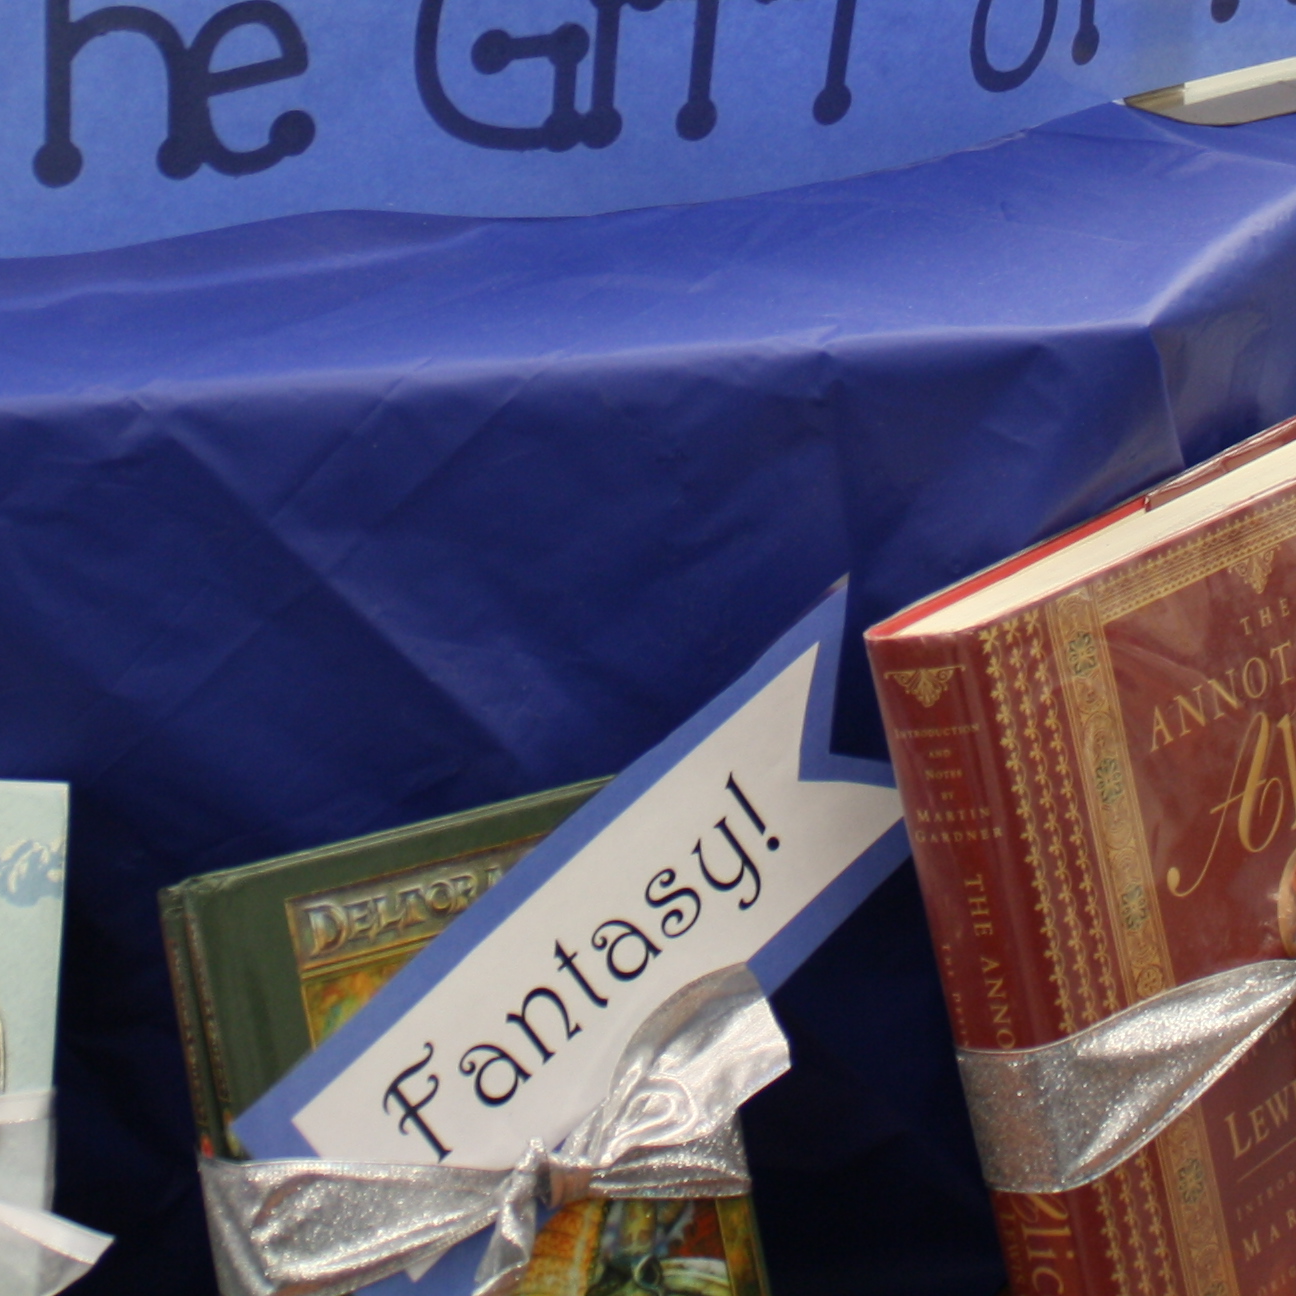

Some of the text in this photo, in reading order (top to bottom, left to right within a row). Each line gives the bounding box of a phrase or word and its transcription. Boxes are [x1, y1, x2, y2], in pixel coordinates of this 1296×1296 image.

[1239, 597, 1291, 636] THE
[915, 826, 1003, 843] GARDNER
[964, 873, 993, 936] THE
[381, 772, 781, 1162] Fantasy!
